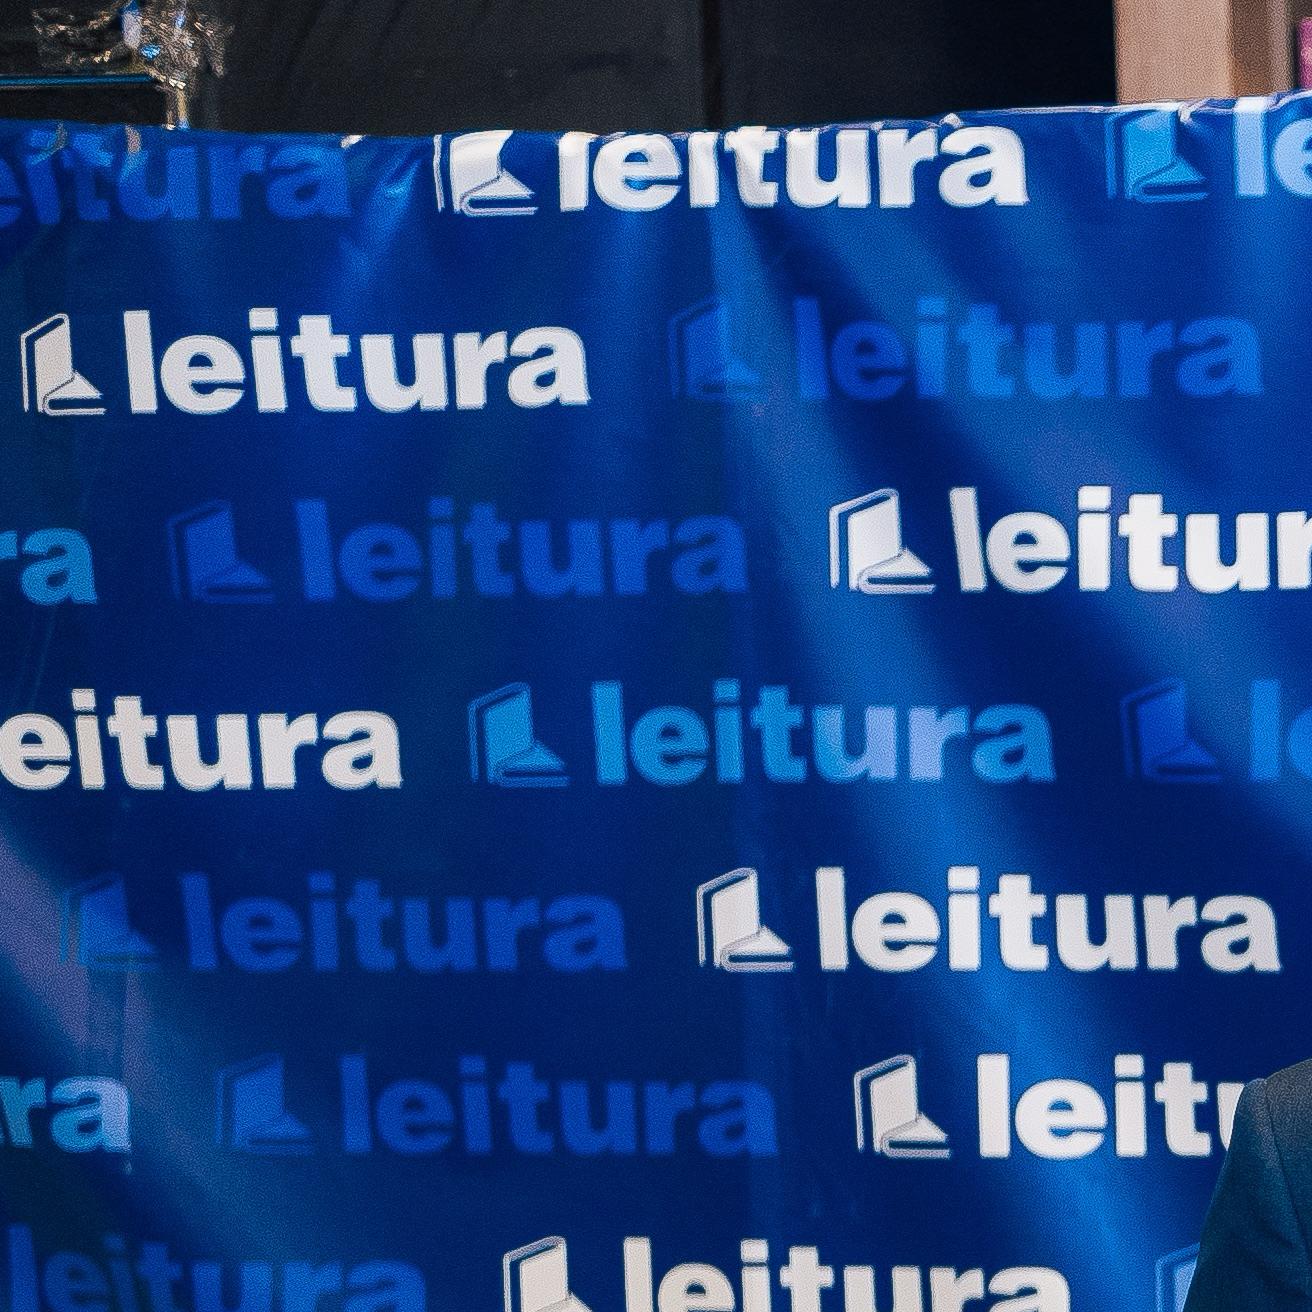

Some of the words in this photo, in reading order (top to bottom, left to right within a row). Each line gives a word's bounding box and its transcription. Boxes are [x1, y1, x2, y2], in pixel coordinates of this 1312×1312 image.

[558, 126, 1029, 212] leitura
[124, 307, 591, 413] leitura
[793, 297, 1263, 400] leitura
[295, 498, 749, 599] leitura
[0, 689, 403, 790] eitura
[592, 679, 1057, 785] leitura
[180, 871, 628, 973] leitura
[815, 866, 1281, 973] leitura
[340, 1055, 779, 1157] leitura
[977, 1053, 1245, 1160] leit
